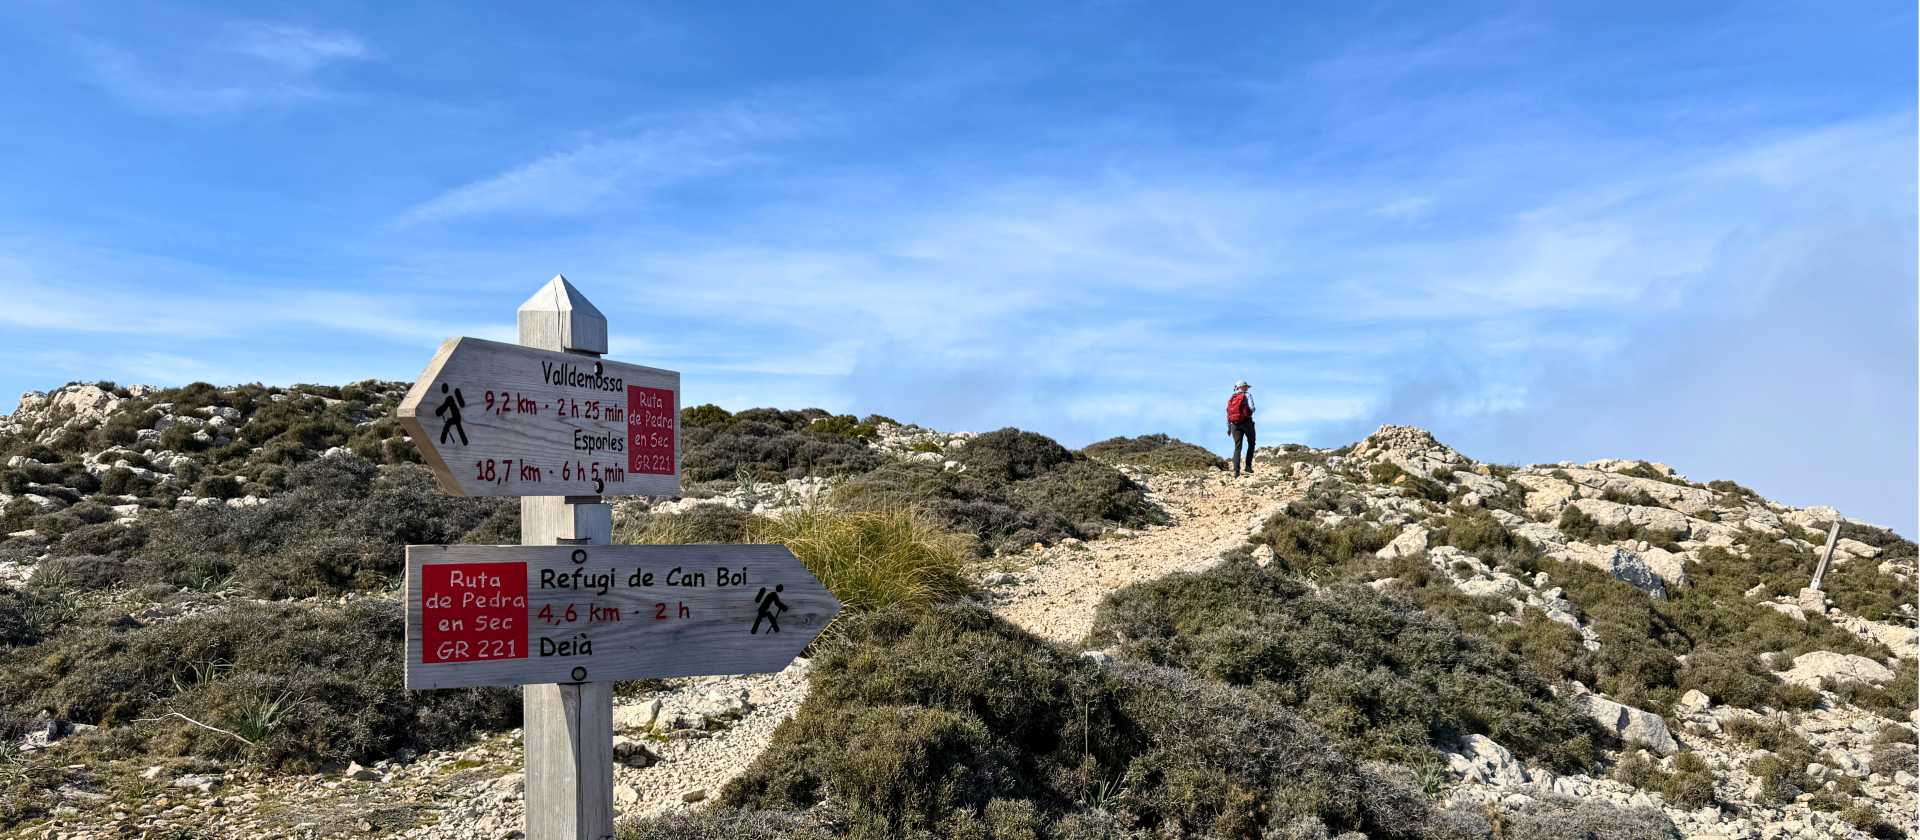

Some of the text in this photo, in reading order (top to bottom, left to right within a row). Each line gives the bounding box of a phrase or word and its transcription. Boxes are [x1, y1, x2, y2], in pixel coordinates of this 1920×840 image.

[542, 360, 624, 392] Valldemossa
[484, 390, 512, 416] 9,2
[517, 392, 537, 416] km
[557, 398, 566, 416] 2
[571, 400, 579, 419] h
[584, 400, 600, 421] 25
[604, 402, 624, 422] min
[639, 391, 663, 409] Ruta
[628, 407, 673, 429] de Pedra
[573, 428, 624, 455] Esporles
[634, 432, 669, 448] en Sec
[476, 458, 513, 485] 18,7
[520, 459, 541, 483] km
[562, 460, 571, 481] 6
[577, 461, 586, 482] h
[591, 462, 599, 480] 5
[604, 462, 625, 483] min
[635, 454, 671, 472] GR 221
[450, 569, 501, 588] Ruta
[540, 566, 748, 596] Refugi de Can Boi
[425, 591, 526, 609] de Pedra
[438, 614, 513, 632] en Sec
[537, 603, 578, 627] 4,6
[589, 602, 620, 624] km
[655, 602, 669, 621] 2
[679, 600, 690, 619] h
[436, 640, 517, 660] GR 221
[540, 632, 593, 657] Deià
